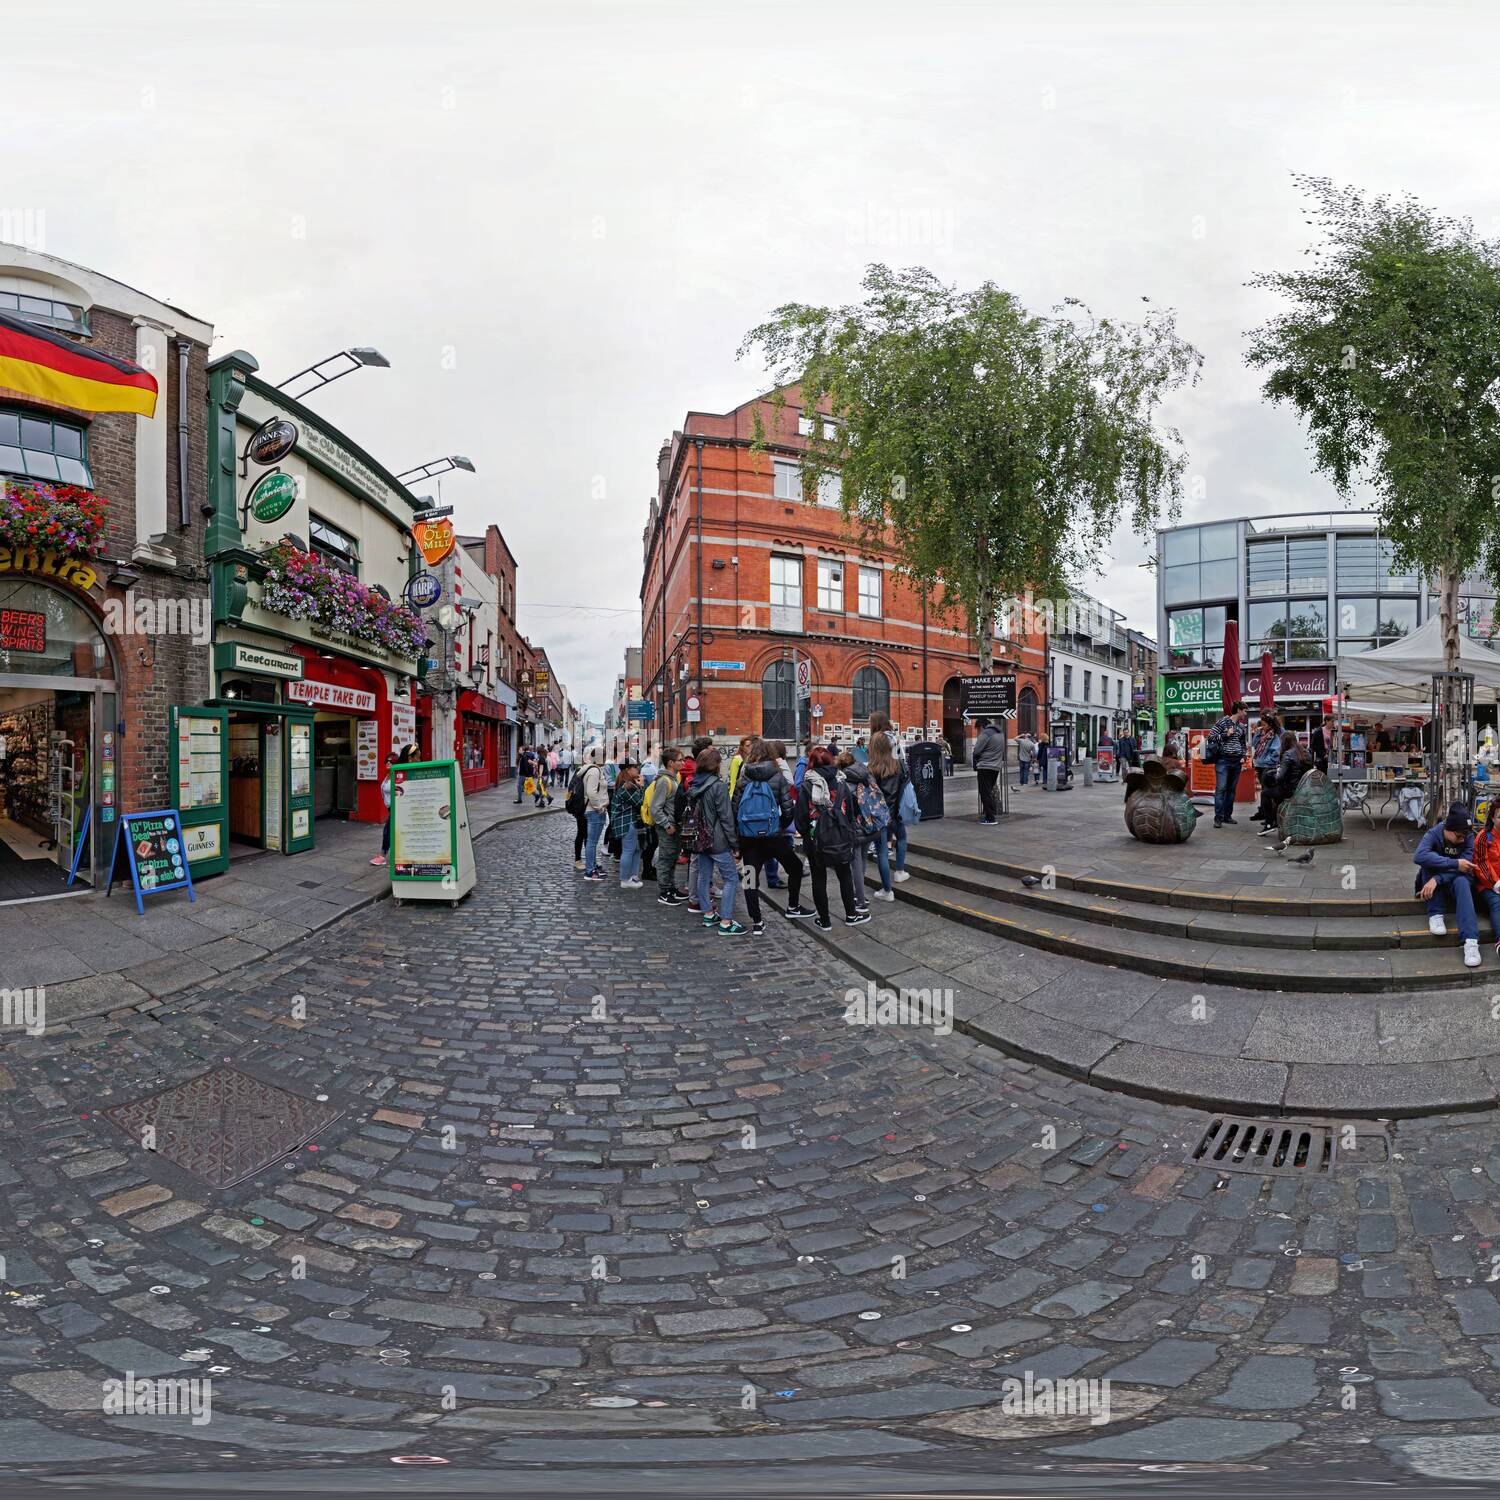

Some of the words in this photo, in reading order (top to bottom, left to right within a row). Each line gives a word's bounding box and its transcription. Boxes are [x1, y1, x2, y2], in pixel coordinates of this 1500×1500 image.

[424, 529, 451, 541] OLD
[423, 540, 450, 550] MILL
[412, 580, 435, 597] HARP
[1, 610, 45, 626] BEERS
[1, 637, 45, 652] SPIRITS
[1177, 678, 1223, 690] TOURIST
[1286, 677, 1325, 692] Vivaldi
[293, 682, 329, 701] TEMPLE
[332, 689, 354, 705] TAKE
[356, 693, 372, 707] OUT
[1181, 690, 1220, 701] OFFICE
[142, 821, 163, 831] Pizza
[187, 840, 215, 853] GUINNESS
